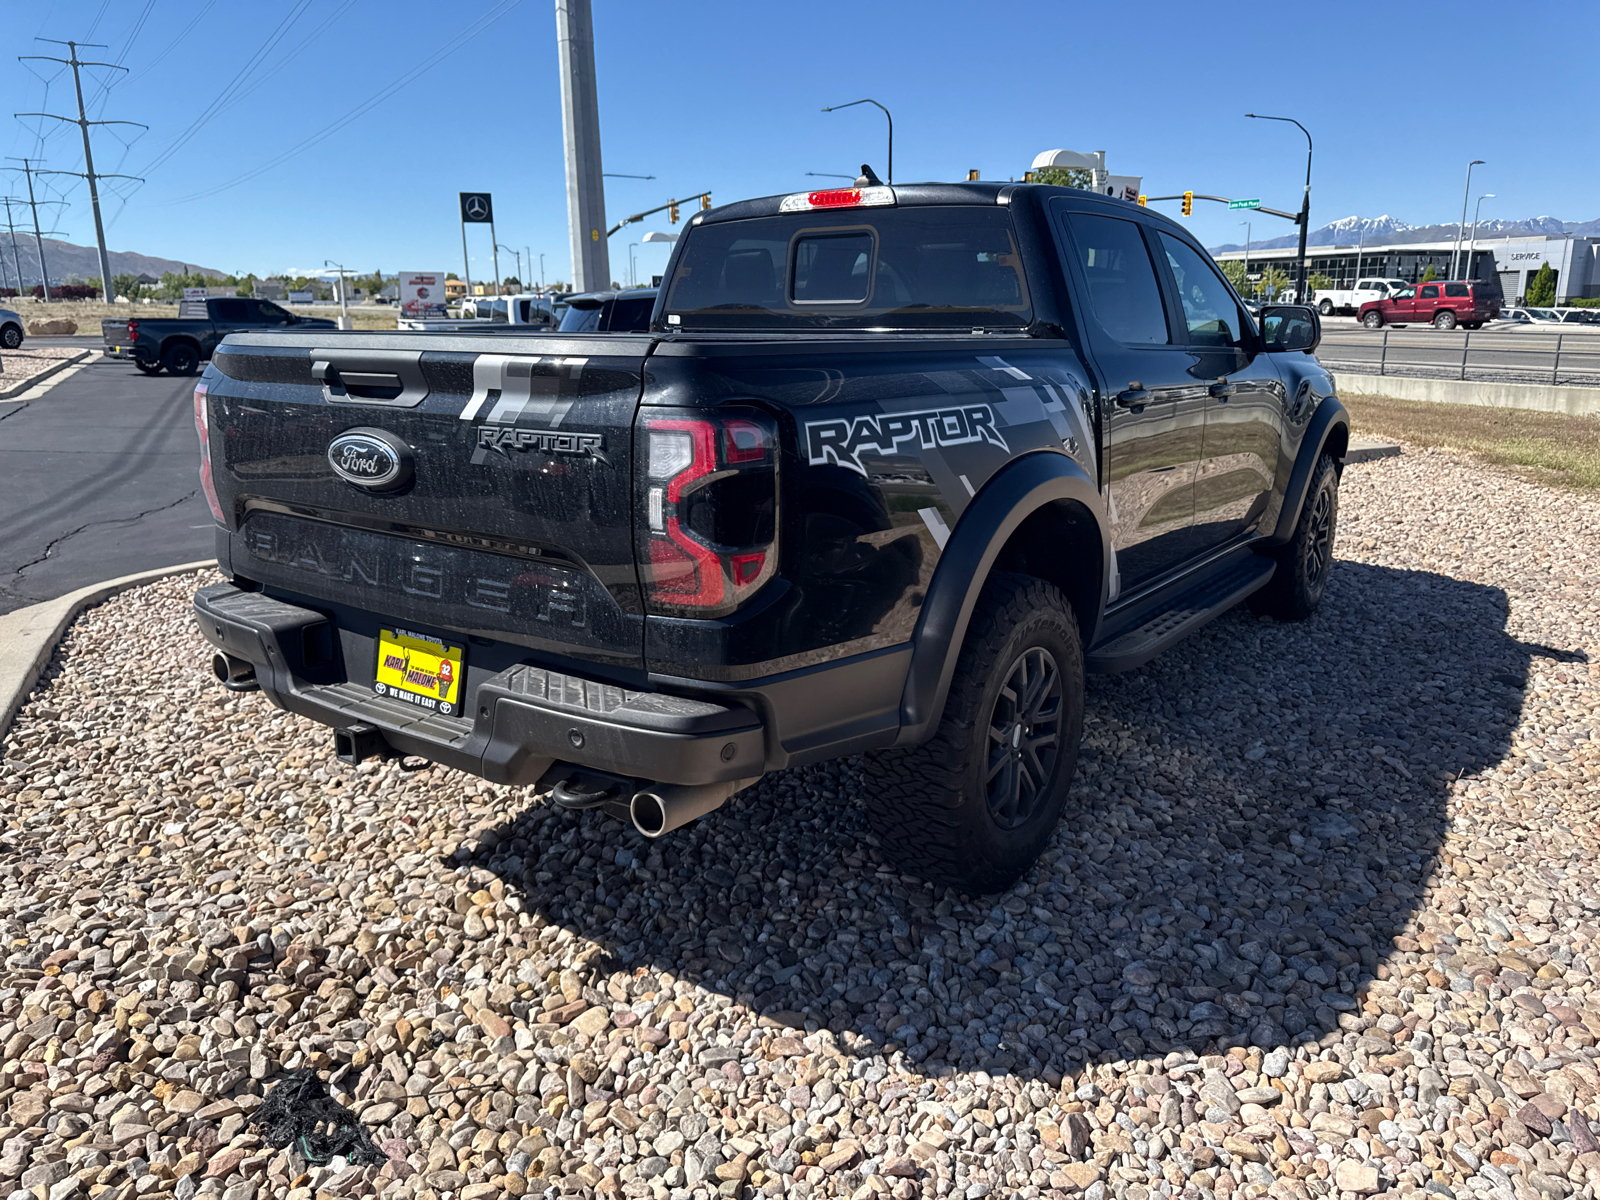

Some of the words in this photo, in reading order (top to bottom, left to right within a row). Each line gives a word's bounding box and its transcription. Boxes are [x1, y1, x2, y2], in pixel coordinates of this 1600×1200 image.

[1511, 252, 1541, 260] SERVICE
[477, 425, 615, 470] RAPTOR
[804, 403, 1011, 478] RAPTOR
[340, 444, 378, 474] Ford
[250, 529, 587, 629] RANGER
[395, 628, 408, 636] KARL
[407, 630, 426, 641] MALONE
[426, 635, 443, 645] TOYOTA
[383, 654, 405, 671] KARL
[406, 669, 438, 690] MALONE
[441, 664, 451, 676] 32
[389, 687, 399, 698] WE
[398, 690, 415, 702] MAKE
[414, 694, 421, 705] IT
[421, 696, 436, 709] EASY
